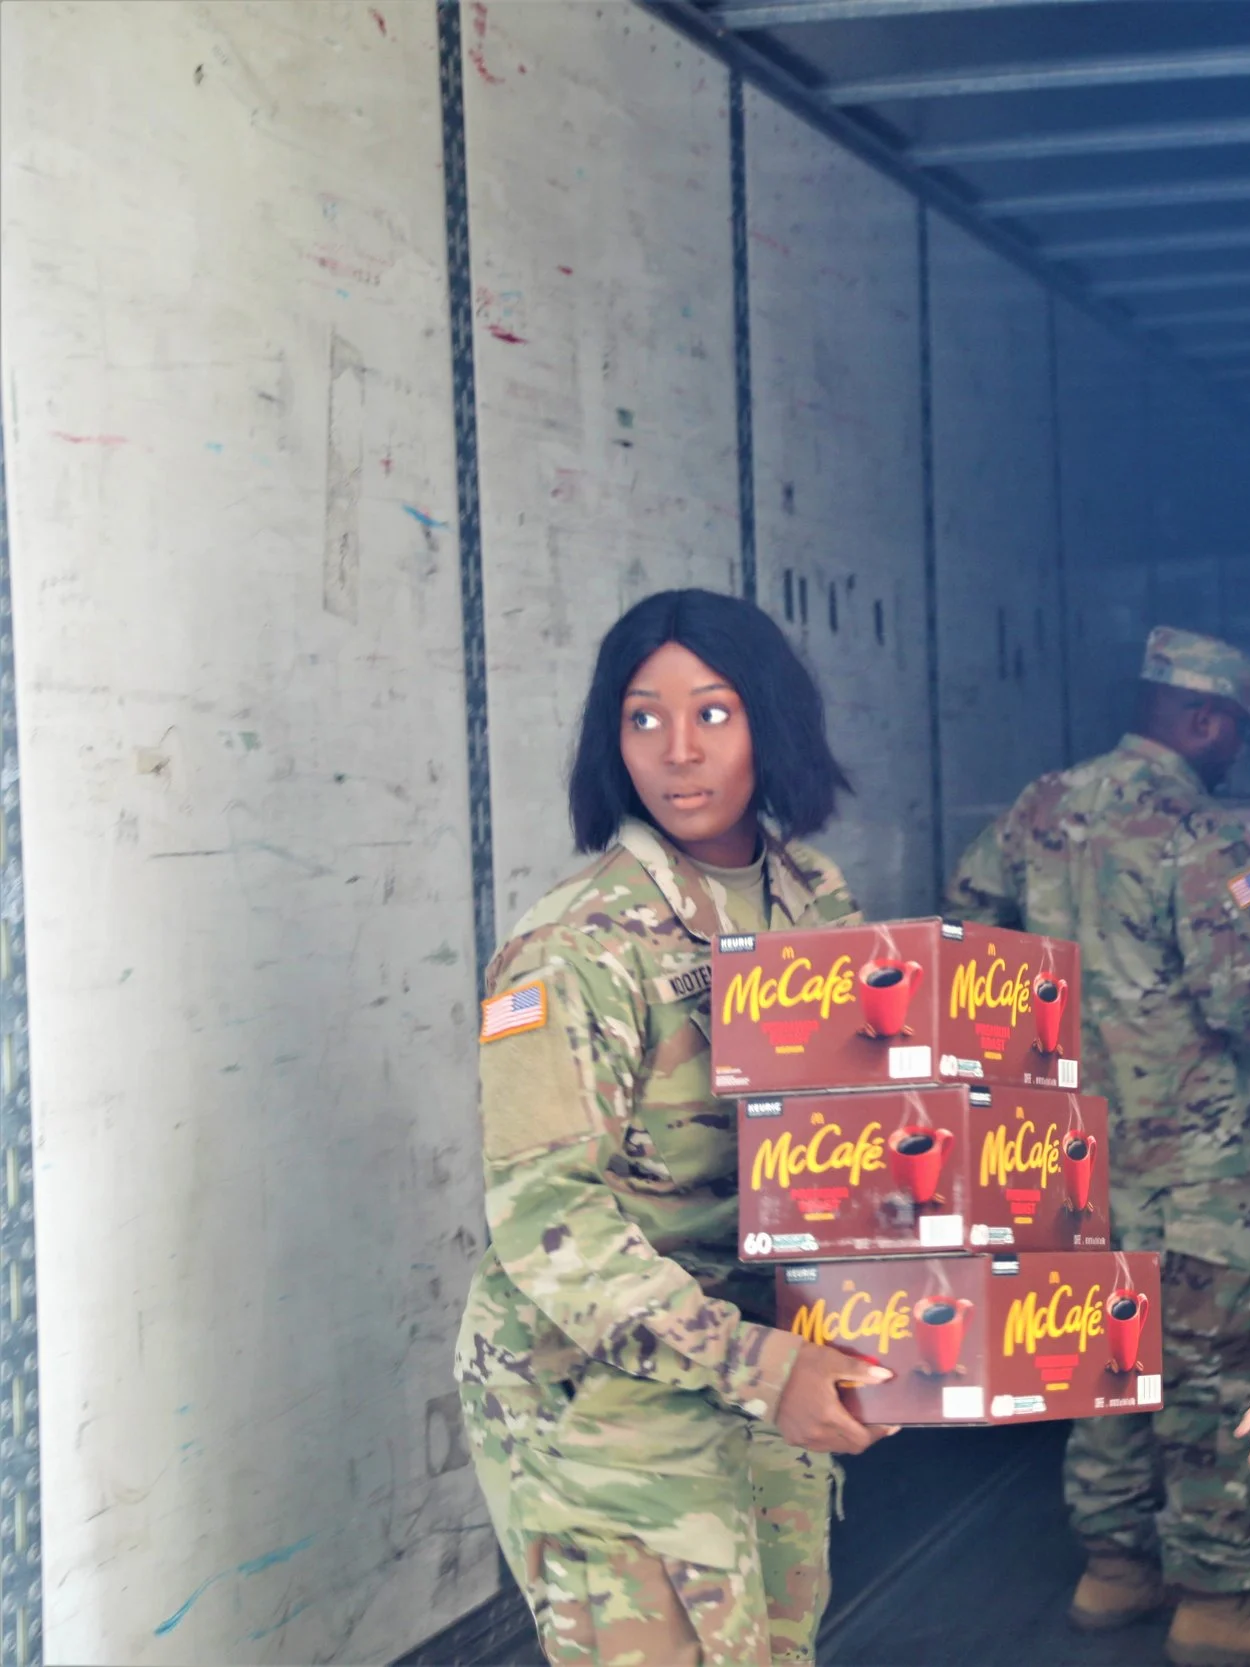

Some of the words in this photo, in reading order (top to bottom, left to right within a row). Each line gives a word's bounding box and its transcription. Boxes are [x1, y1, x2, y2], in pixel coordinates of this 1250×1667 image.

[720, 936, 755, 949] KEURIG
[721, 955, 851, 1025] McCafé
[949, 957, 1030, 1028] McCafé
[751, 1121, 885, 1191] McCafé
[980, 1120, 1060, 1189] McCafé
[744, 1232, 772, 1255] 60
[791, 1291, 911, 1355] McCafé
[1003, 1284, 1103, 1357] McCafé
